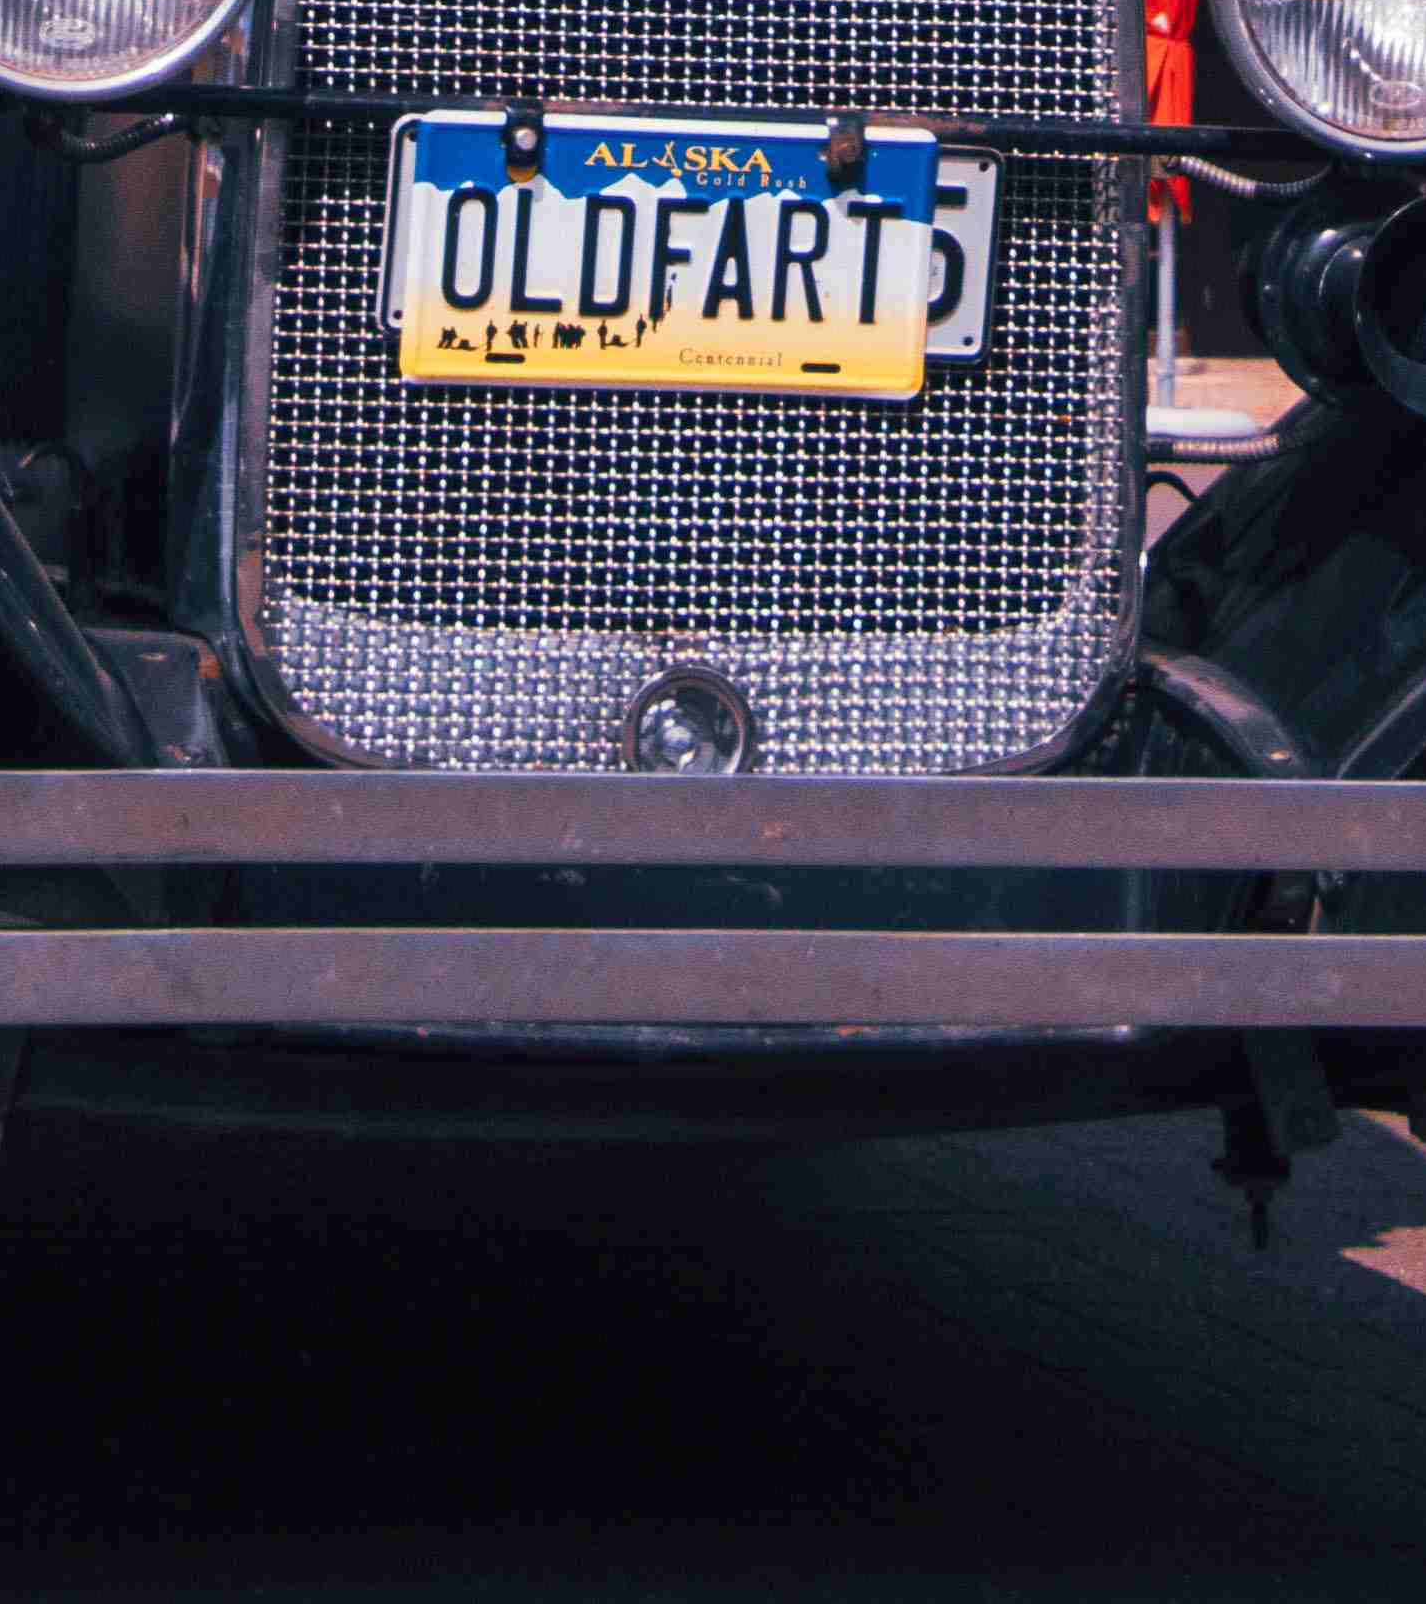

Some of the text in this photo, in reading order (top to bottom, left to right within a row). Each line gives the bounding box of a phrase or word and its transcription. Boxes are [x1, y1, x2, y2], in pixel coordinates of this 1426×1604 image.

[584, 141, 773, 174] ALASKA
[696, 172, 745, 187] Gold
[440, 188, 904, 325] OLDFART
[678, 347, 783, 367] Centennial
